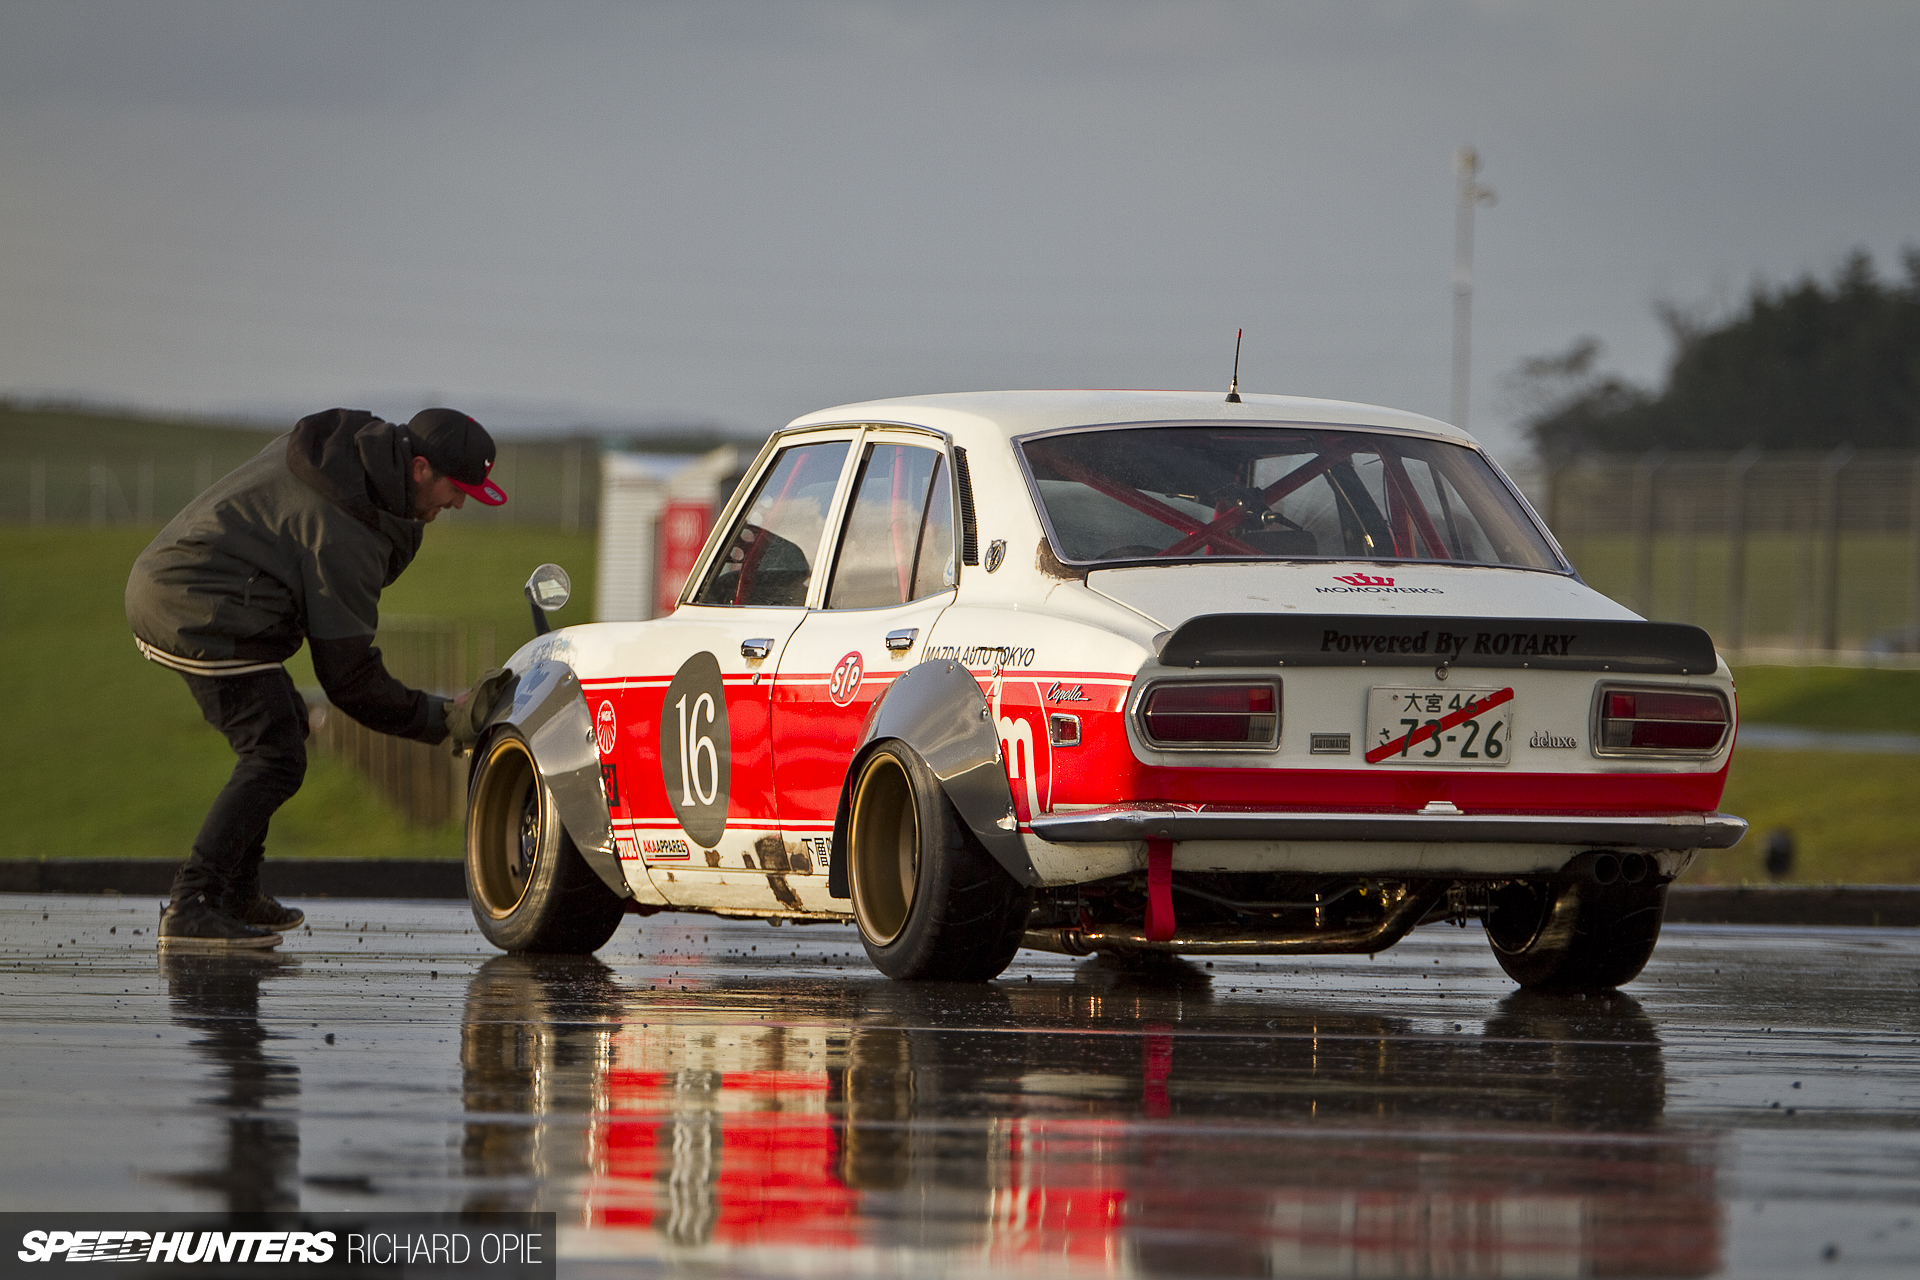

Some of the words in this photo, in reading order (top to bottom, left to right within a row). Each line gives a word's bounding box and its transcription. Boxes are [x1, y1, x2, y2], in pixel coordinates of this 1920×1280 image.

[1315, 586, 1445, 595] MOMOWERKS
[1320, 630, 1430, 654] Powered
[1434, 632, 1469, 661] By
[1473, 632, 1577, 656] ROTARY
[925, 646, 961, 663] MAZDA
[961, 646, 992, 666] AUTO
[994, 646, 1035, 668] TOKYO
[831, 655, 859, 700] STP
[1046, 681, 1091, 704] Capella
[1403, 692, 1444, 713] 大宮
[1448, 693, 1479, 714] 46
[674, 691, 719, 807] 16
[1314, 738, 1350, 749] AUTOMATIC
[1400, 717, 1504, 759] 73-26
[1529, 730, 1578, 749] deluxe
